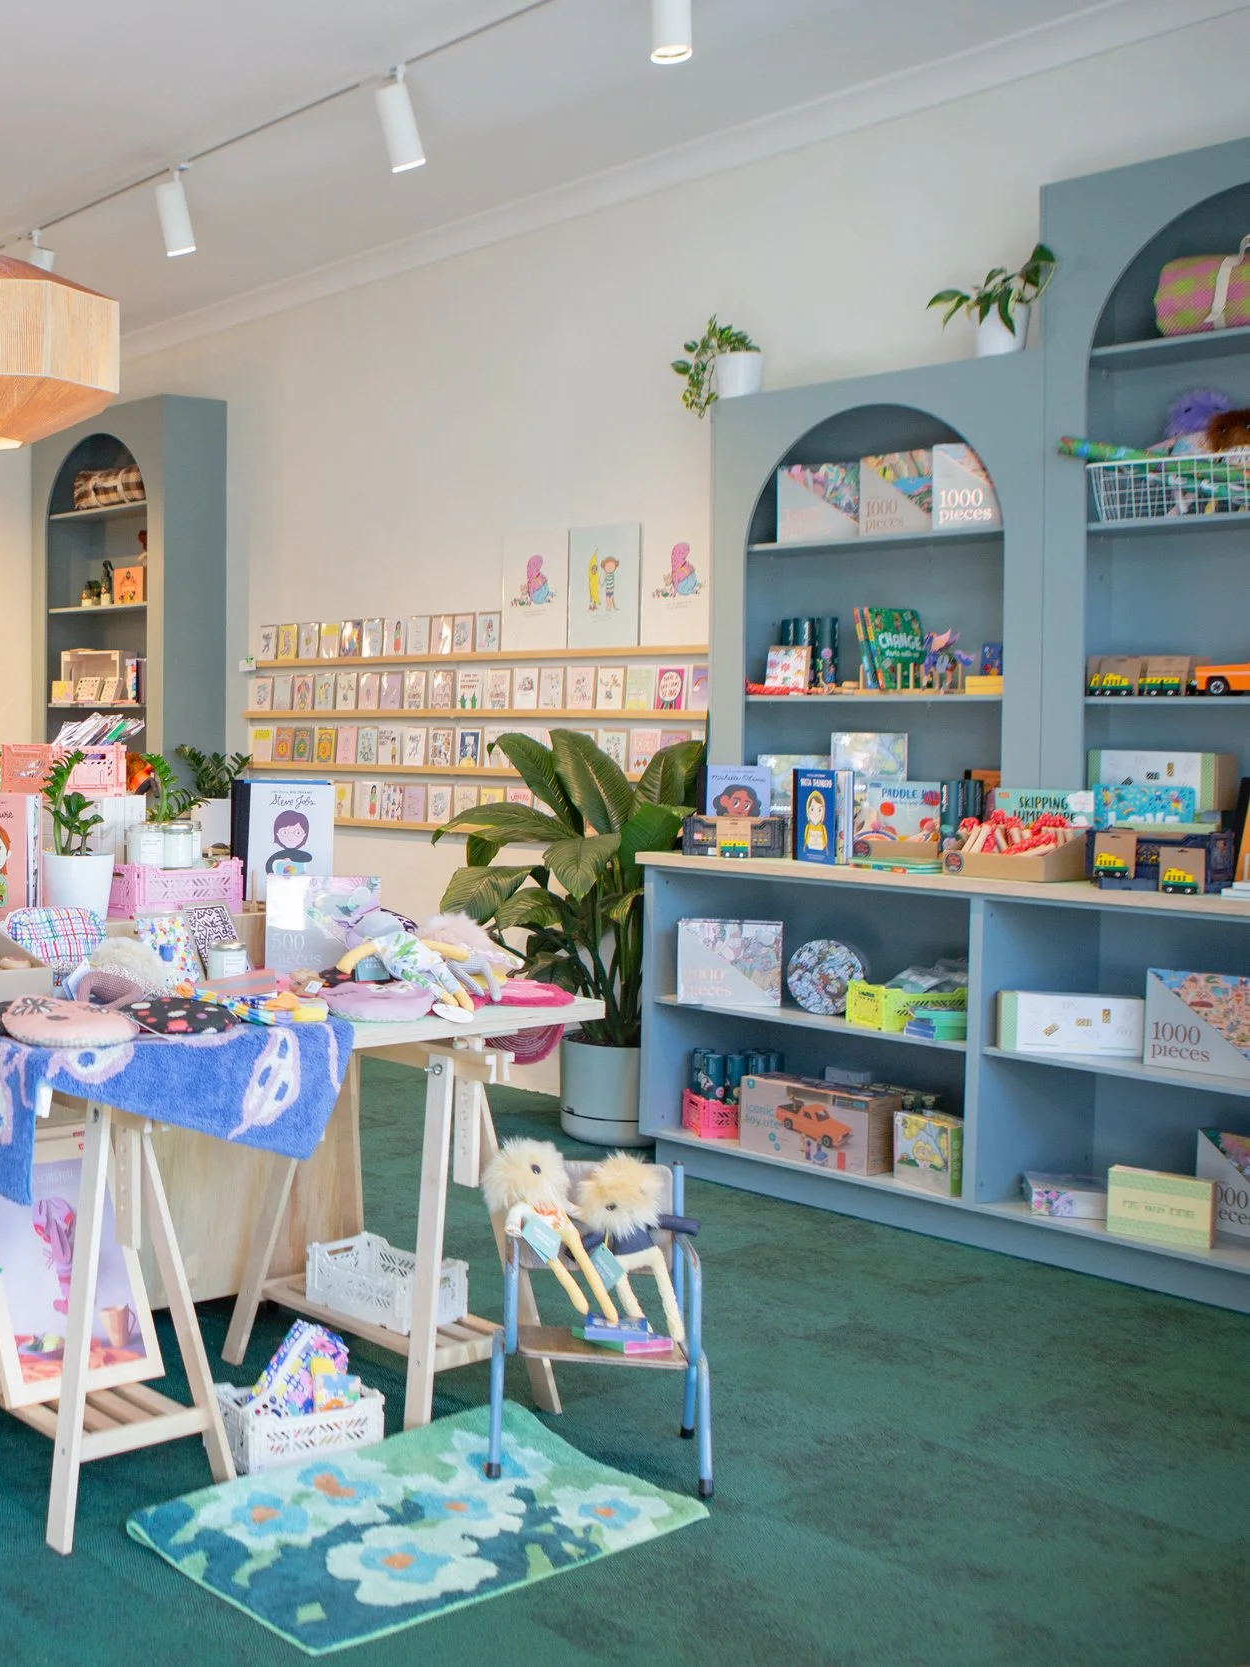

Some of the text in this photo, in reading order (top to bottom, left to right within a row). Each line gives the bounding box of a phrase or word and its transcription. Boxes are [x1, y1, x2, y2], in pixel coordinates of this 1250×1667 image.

[939, 488, 983, 508] 1000
[865, 499, 898, 518] 1000
[939, 505, 993, 525] pieces
[865, 515, 904, 533] pieces
[878, 631, 921, 650] CHANGE
[269, 794, 316, 810] Steve Jobs
[881, 788, 918, 800] PADDLE
[1019, 795, 1069, 810] SKIPPING
[271, 932, 305, 951] 500
[1152, 1020, 1201, 1046] 1000
[1151, 1043, 1210, 1063] pieces
